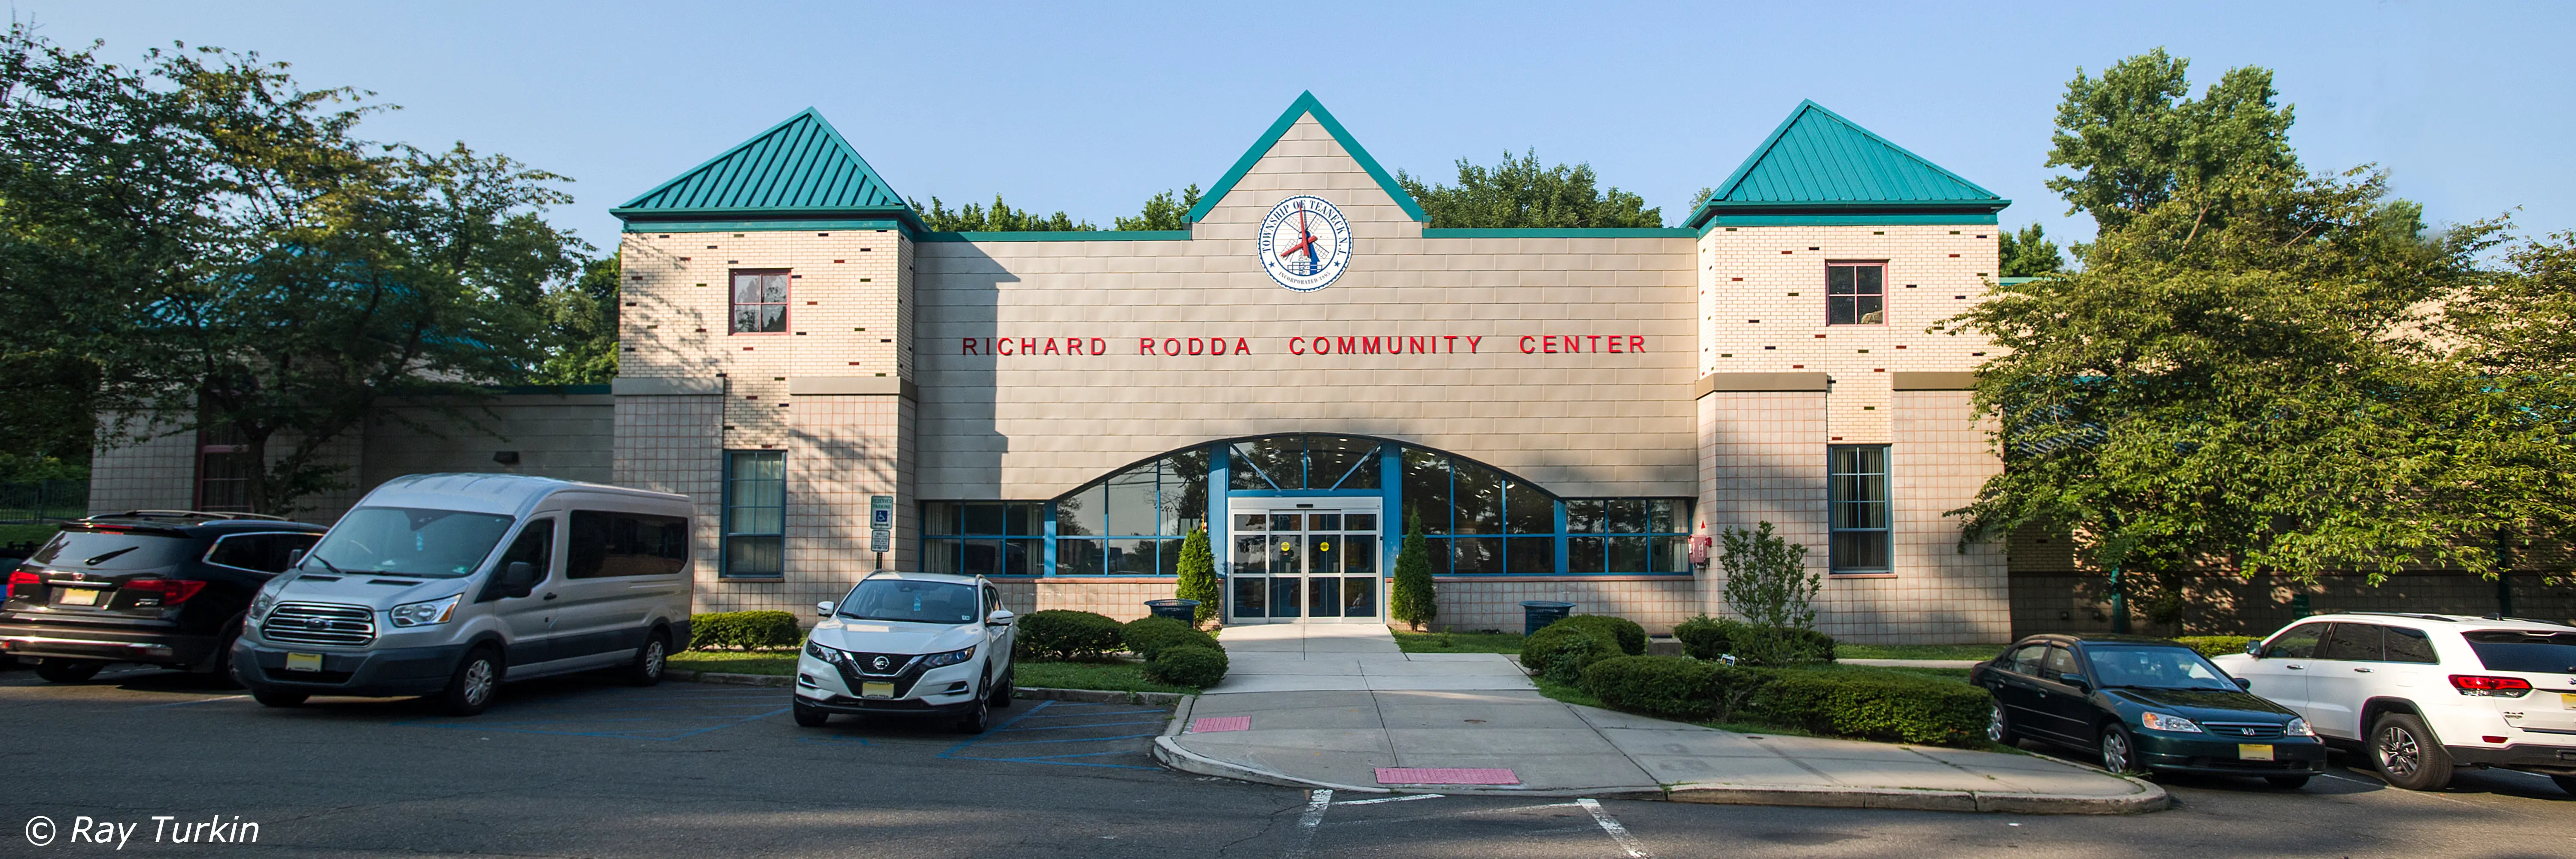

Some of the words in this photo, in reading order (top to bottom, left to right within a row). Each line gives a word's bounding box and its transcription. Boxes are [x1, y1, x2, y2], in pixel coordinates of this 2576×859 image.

[1262, 204, 1289, 253] TOWNSHIP
[1293, 200, 1306, 210] OF
[1309, 200, 1346, 235] TEANECK
[1279, 271, 1318, 284] INCORPORATED
[1319, 271, 1330, 280] 1895
[962, 338, 1106, 356] RICHARD
[1140, 337, 1251, 356] RODDA
[1289, 335, 1482, 355] COMMUNITY
[1519, 335, 1646, 353] CENTER
